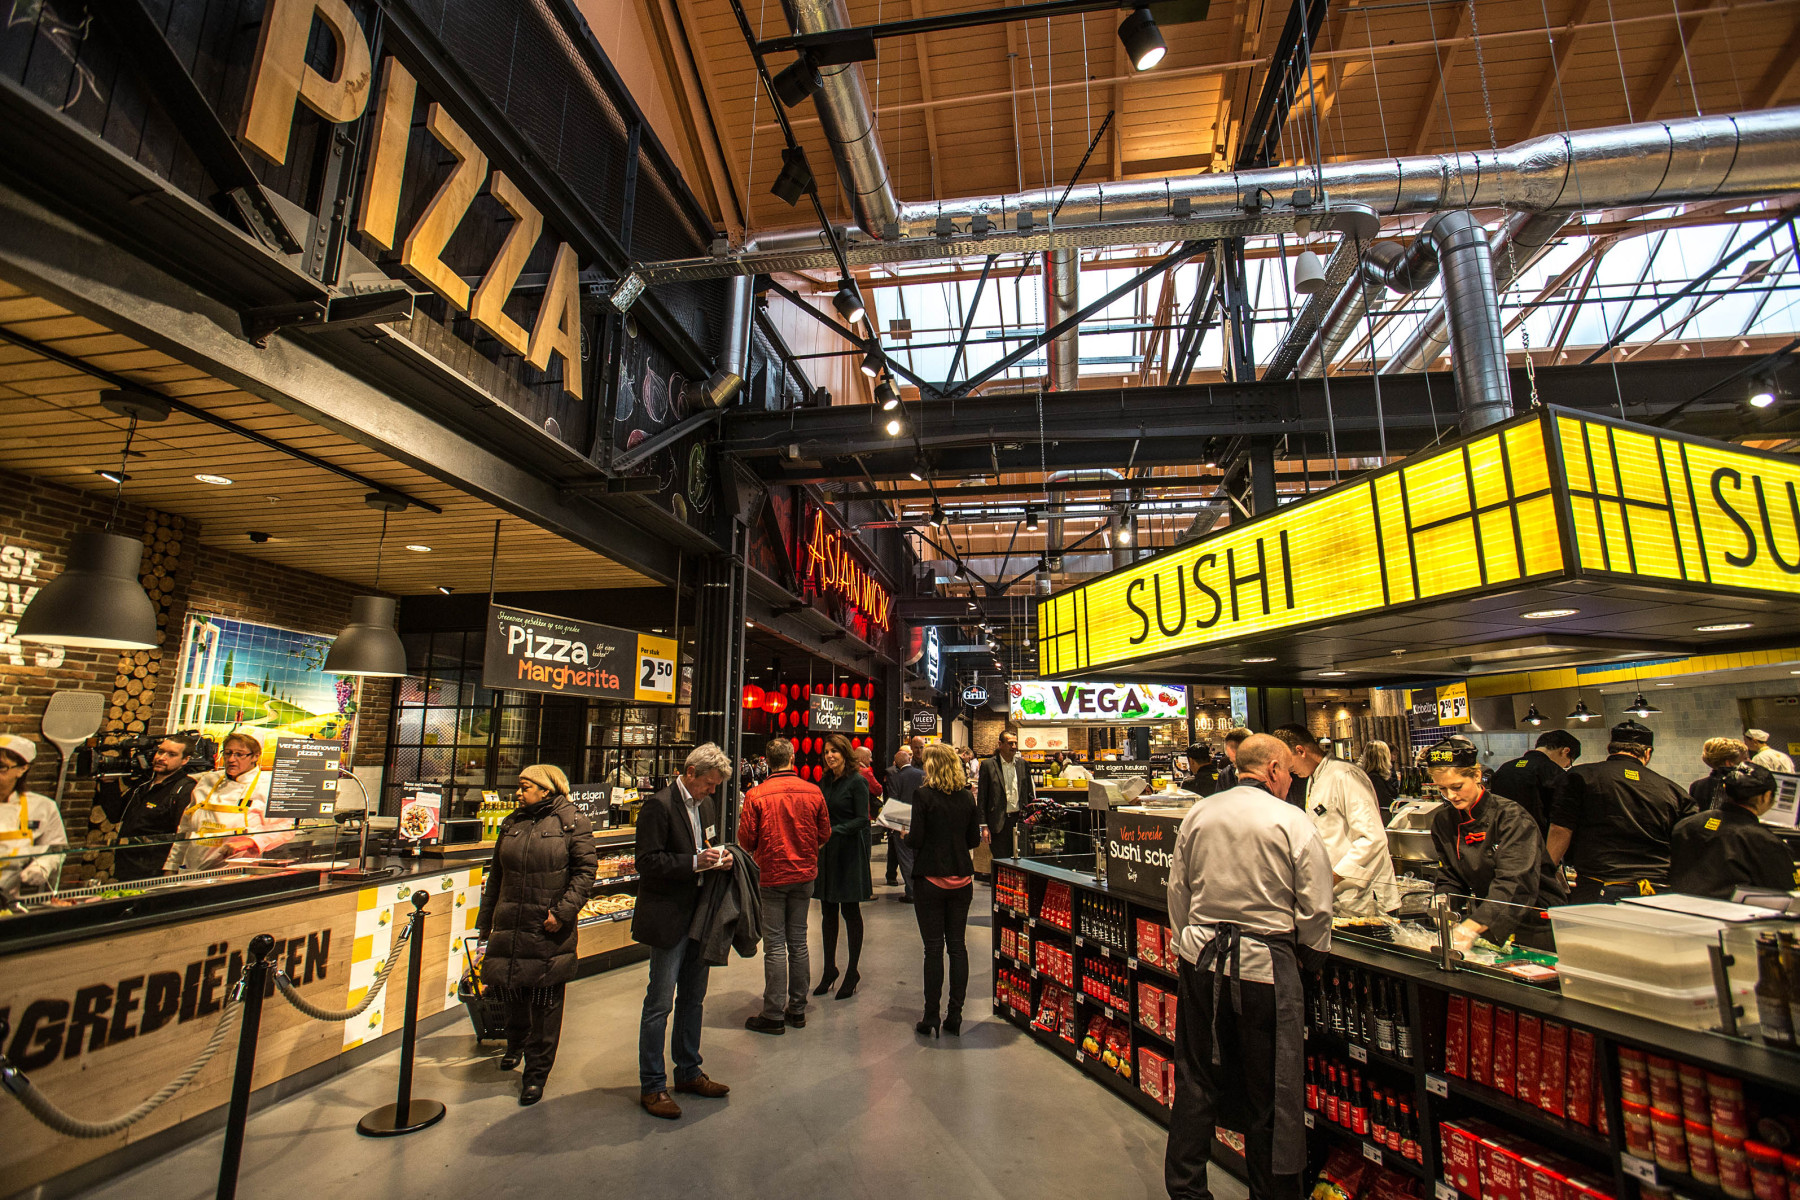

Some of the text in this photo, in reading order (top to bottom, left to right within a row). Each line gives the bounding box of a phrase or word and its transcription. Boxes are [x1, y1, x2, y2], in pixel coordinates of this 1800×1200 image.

[238, 0, 583, 400] PIZZA
[1126, 529, 1295, 645] SUSHI
[862, 572, 889, 632] WOK
[507, 624, 589, 666] Pizza
[649, 648, 660, 656] stuk
[518, 658, 620, 690] Margherita
[963, 690, 986, 700] Grill
[1052, 685, 1144, 714] VEGA
[820, 697, 834, 715] Kip
[1413, 702, 1438, 715] Kibbeling
[816, 711, 842, 729] Ketjap
[1106, 764, 1124, 773] eigen
[581, 790, 605, 803] eigen
[1120, 825, 1135, 841] Vers
[1137, 824, 1163, 841] bereide
[1110, 840, 1142, 863] Sushi
[1451, 1146, 1469, 1160] SUSHI
[1453, 1152, 1468, 1167] RICE
[1491, 1165, 1512, 1181] SUSHI
[1493, 1173, 1511, 1189] RICE
